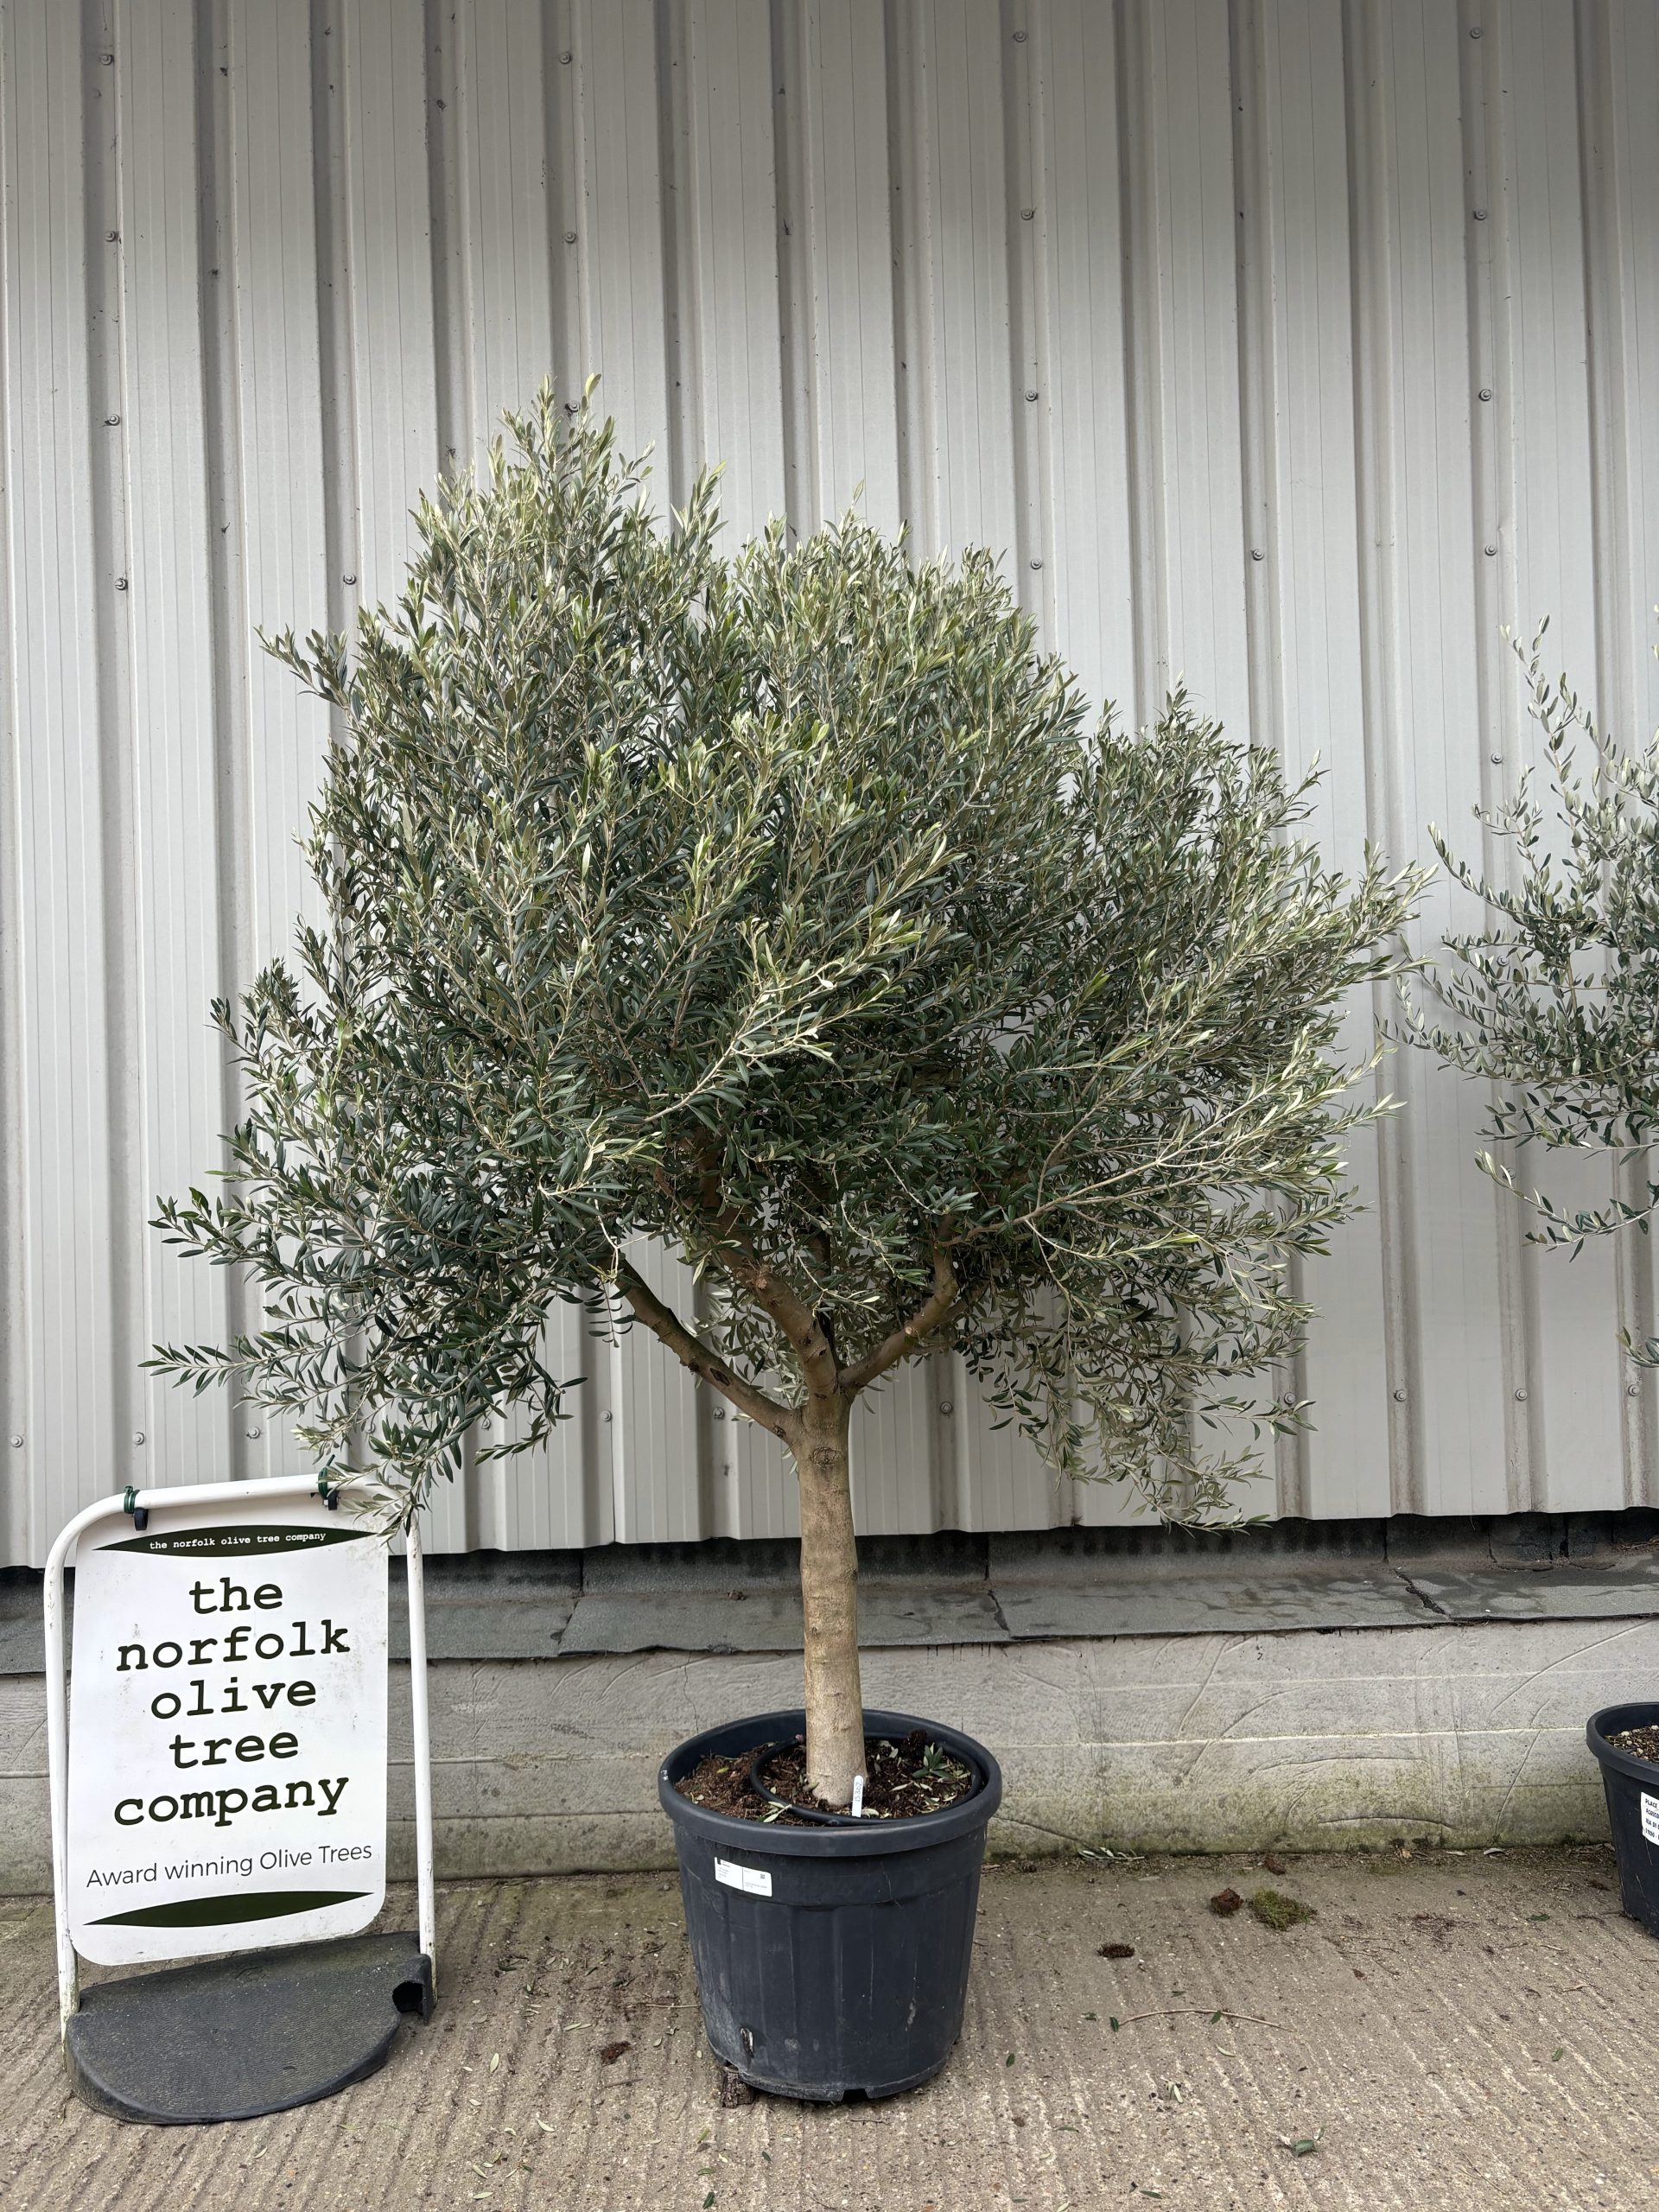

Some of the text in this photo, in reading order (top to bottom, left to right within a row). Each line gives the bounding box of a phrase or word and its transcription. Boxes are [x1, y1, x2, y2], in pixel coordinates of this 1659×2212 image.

[149, 1541, 168, 1550] the
[173, 1537, 216, 1548] norfolk
[220, 1536, 251, 1545] olive
[285, 1533, 327, 1542] company
[189, 1577, 283, 1615] the
[116, 1619, 351, 1672] norfolk
[150, 1676, 316, 1719] olive
[168, 1732, 299, 1769] tree
[114, 1777, 349, 1827] company
[86, 1845, 372, 1888] Award winning Olive Trees
